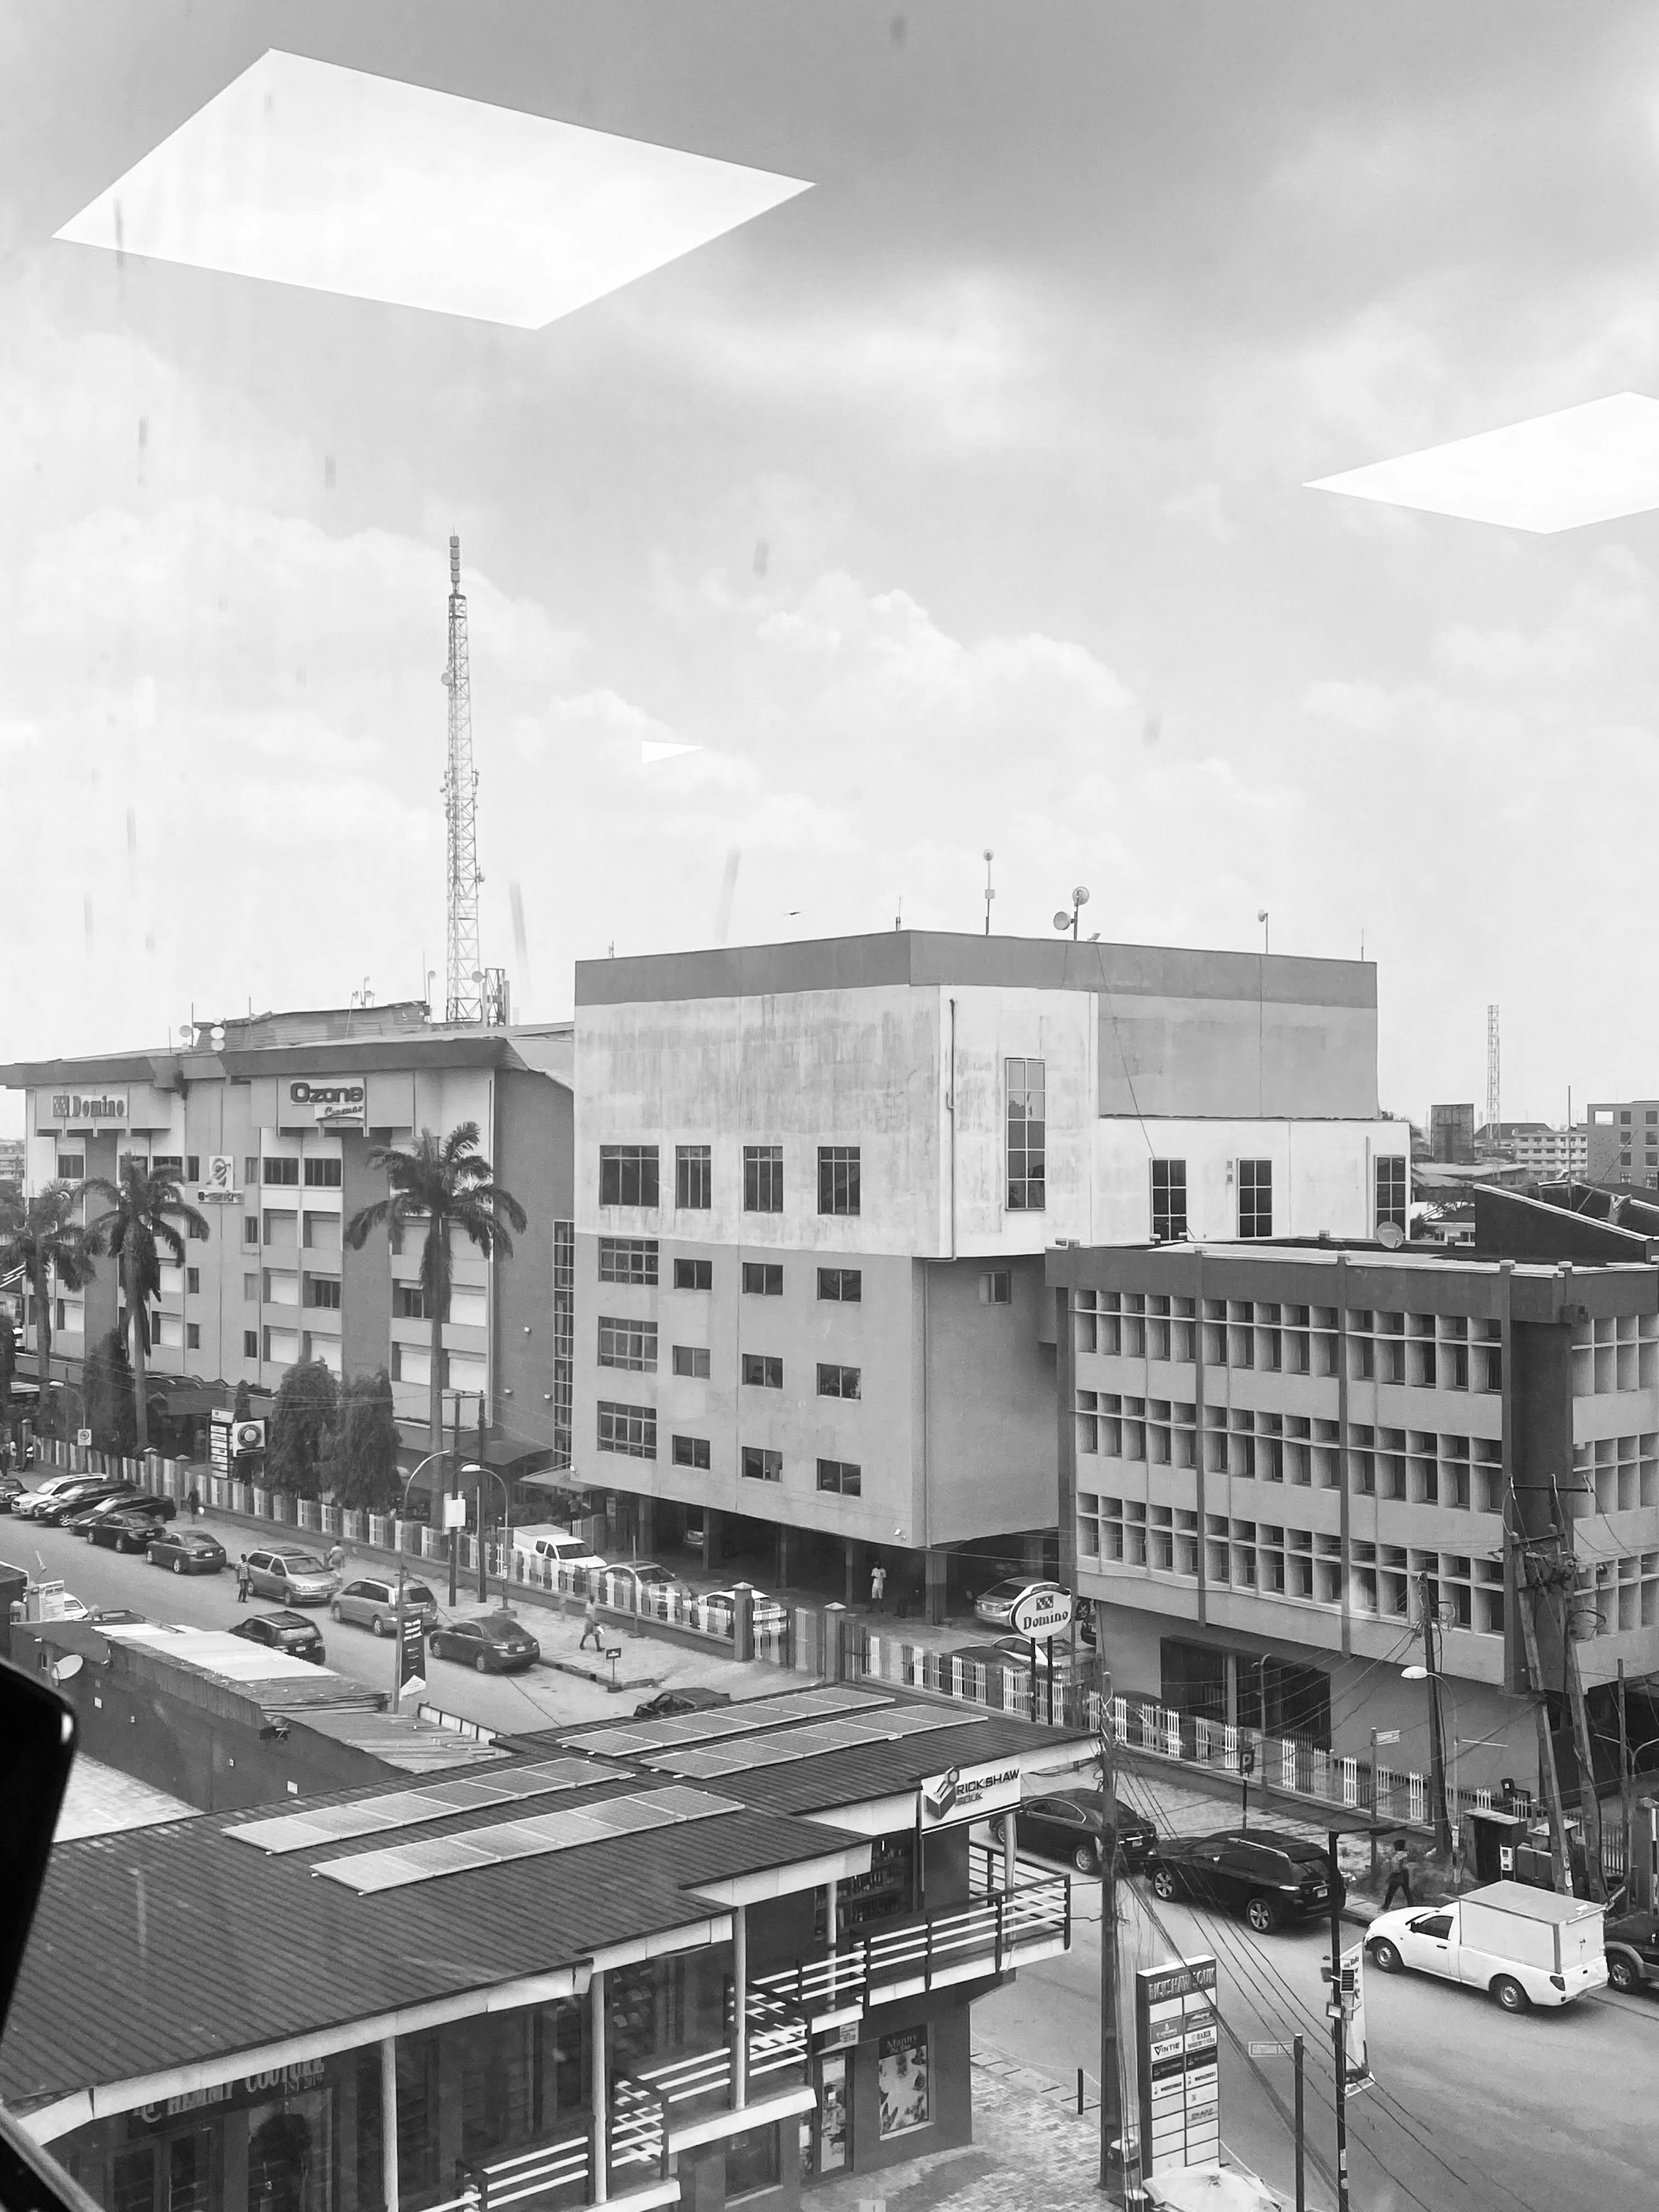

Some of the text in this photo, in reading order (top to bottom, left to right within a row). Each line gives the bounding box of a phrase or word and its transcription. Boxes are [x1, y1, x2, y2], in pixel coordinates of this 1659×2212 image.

[72, 1095, 124, 1117] Domino
[1023, 1610, 1068, 1630] Domino
[957, 1768, 1019, 1795] RICKSHAW
